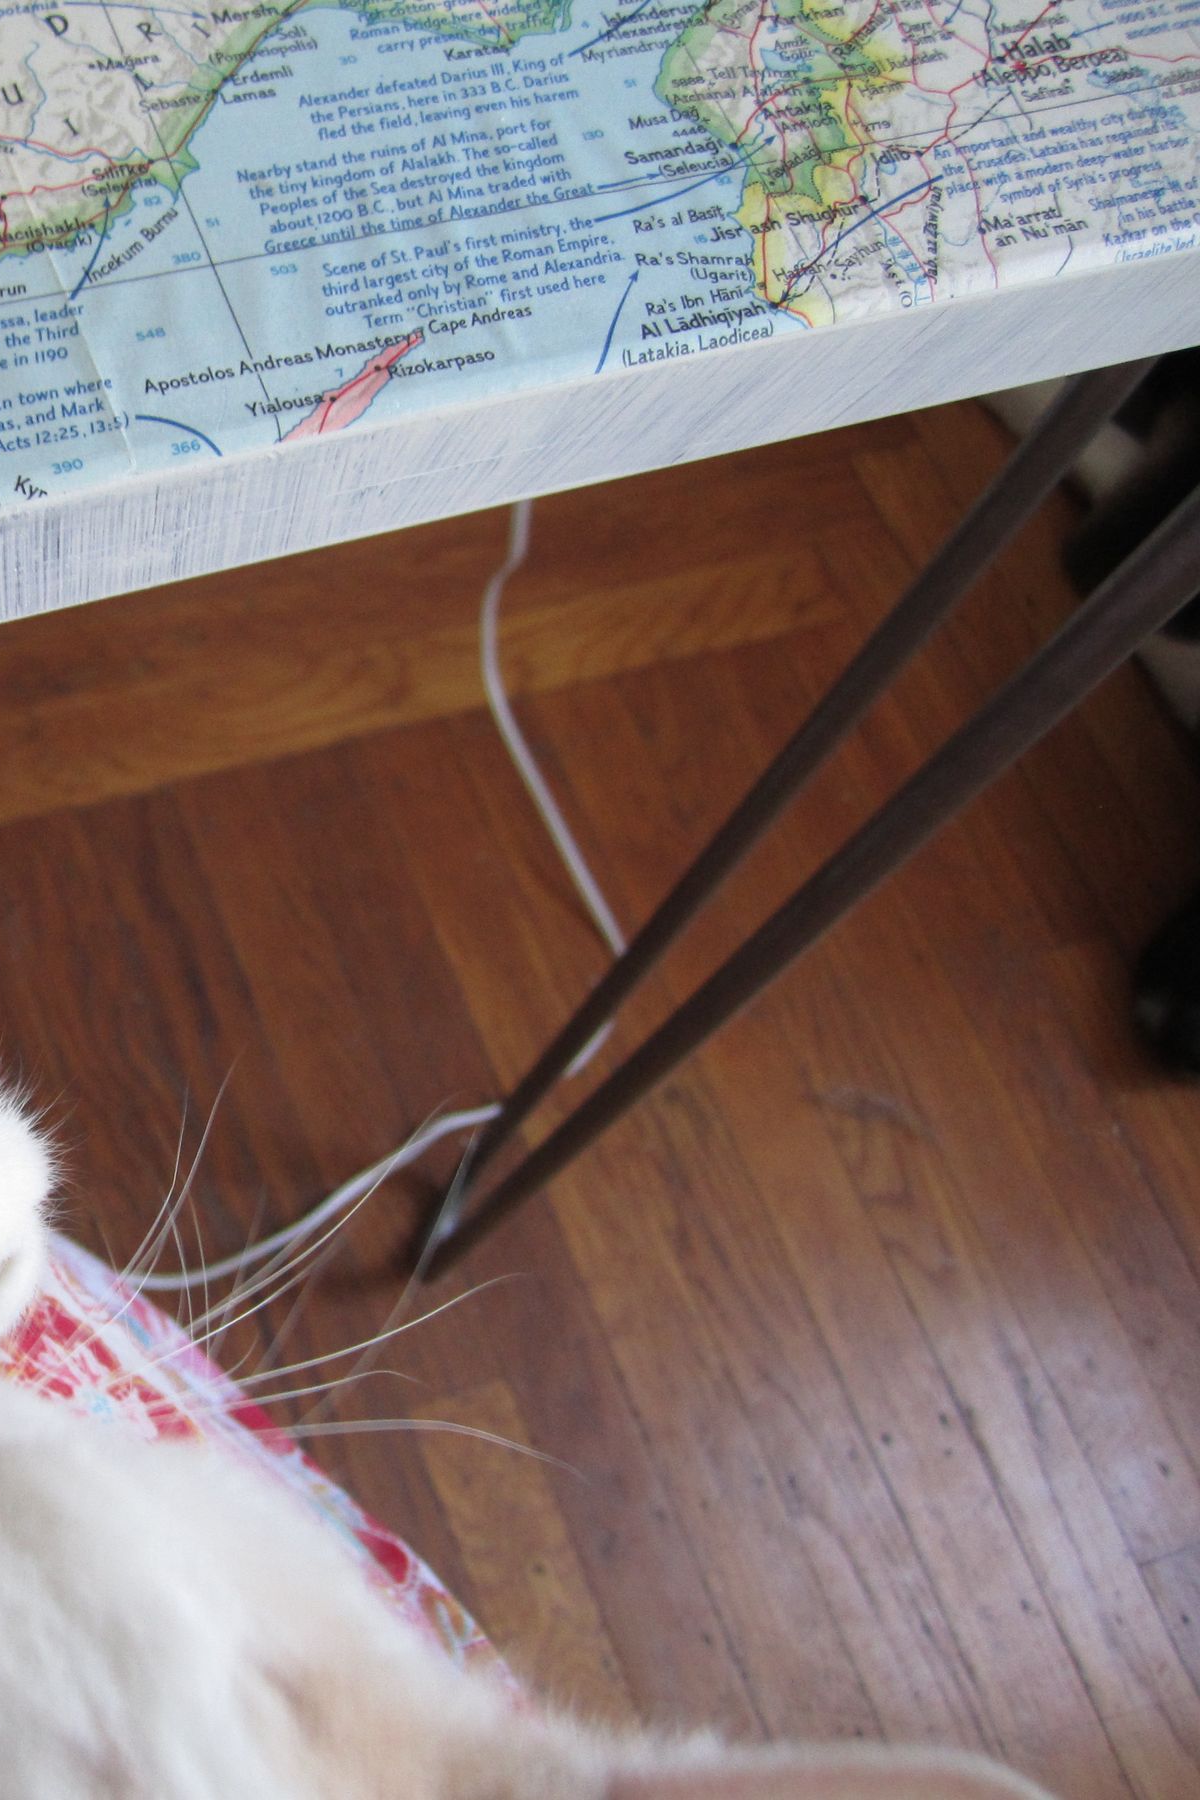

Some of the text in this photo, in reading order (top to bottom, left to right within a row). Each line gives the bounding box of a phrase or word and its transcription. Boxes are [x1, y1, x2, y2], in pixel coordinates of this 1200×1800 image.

[220, 87, 277, 105] Lamas
[299, 58, 547, 108] Alexander defeated Darius King
[407, 94, 440, 110] here
[460, 85, 487, 100] 333
[523, 72, 570, 90] Darius
[318, 125, 347, 142] fled
[420, 105, 472, 125] leaving
[475, 100, 508, 115] even
[511, 94, 532, 109] his
[534, 88, 580, 106] harem
[628, 113, 668, 131] Musa
[236, 163, 292, 184] Nearby
[295, 153, 338, 173] stand
[370, 143, 407, 161] ruins
[496, 124, 527, 142] port
[530, 117, 552, 133] for
[278, 180, 307, 195] tiny
[311, 168, 375, 189] kingdom
[462, 145, 490, 161] The
[495, 133, 558, 158] so-called
[260, 151, 566, 217] Peoples Sea destroyed kingdom
[270, 215, 314, 234] about
[397, 196, 423, 212] but
[447, 184, 484, 203] Mina
[488, 174, 536, 195] traded
[540, 168, 572, 185] with
[264, 182, 595, 255] Greece until time Alexander Great
[322, 259, 367, 278] Scene
[465, 233, 498, 251] first
[322, 278, 361, 298] third
[364, 268, 417, 290] largest
[421, 262, 449, 280] city
[502, 244, 554, 263] Roman
[34, 304, 85, 324] leader
[325, 290, 404, 317] outranked
[407, 283, 439, 301] only
[464, 271, 507, 290] Rome
[364, 272, 607, 330] Term first used here
[35, 322, 80, 342] Third
[428, 305, 533, 336] Cape Andreas
[641, 322, 662, 340] Al
[144, 332, 411, 396] Apostolos Andreas Monastery
[388, 350, 495, 379] Rizokarpaso
[18, 387, 59, 406] town
[64, 377, 113, 397] where
[61, 398, 106, 418] Mark
[245, 393, 323, 417] Yialousa
